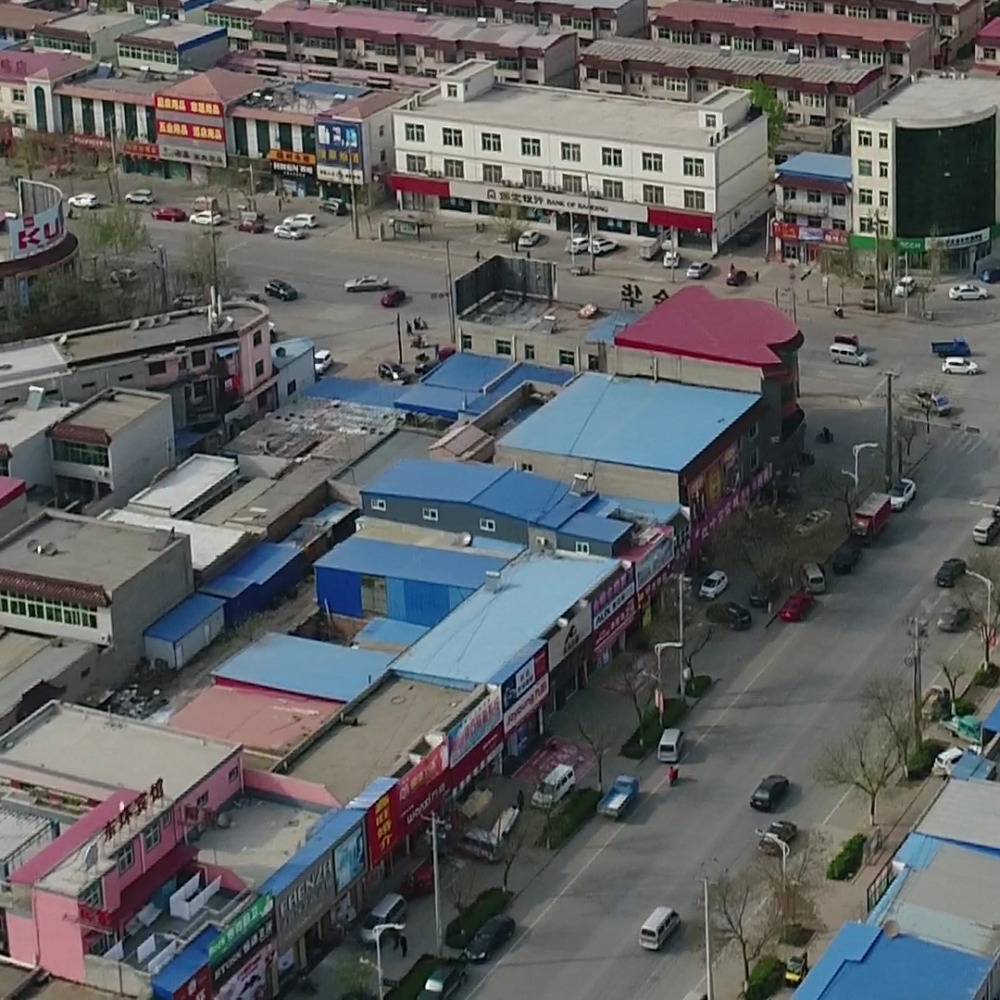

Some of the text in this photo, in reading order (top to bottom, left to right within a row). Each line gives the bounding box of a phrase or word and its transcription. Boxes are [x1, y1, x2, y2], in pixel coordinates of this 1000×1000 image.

[500, 191, 544, 206] 保定银行
[546, 198, 564, 208] BANK
[566, 201, 576, 209] OF
[103, 777, 164, 843] 东环宾馆
